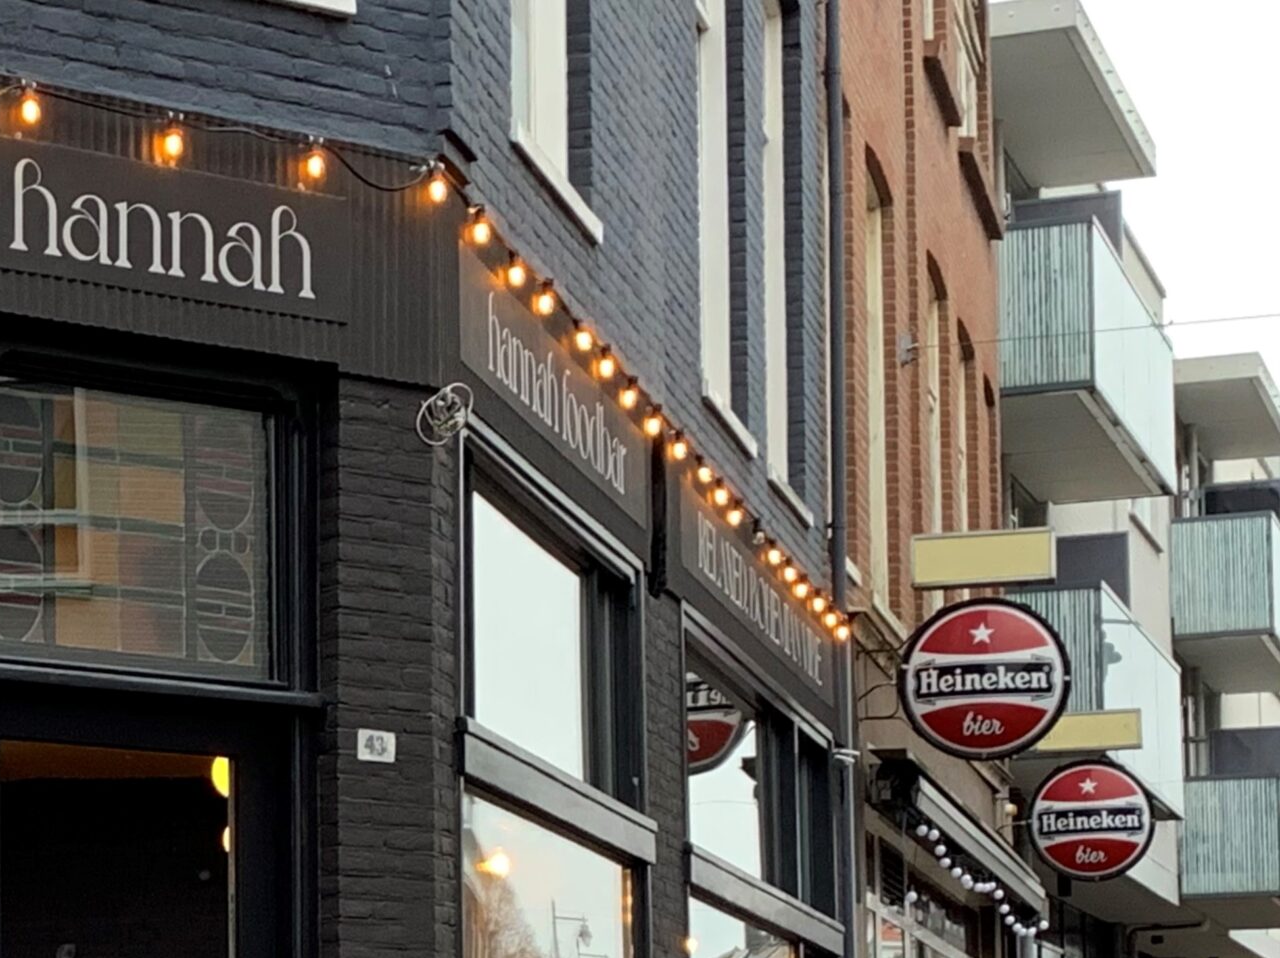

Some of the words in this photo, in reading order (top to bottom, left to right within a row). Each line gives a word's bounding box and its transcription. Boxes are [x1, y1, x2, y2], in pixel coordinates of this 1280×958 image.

[9, 158, 316, 299] hannah
[919, 665, 1049, 694] Heineken
[962, 711, 1006, 736] bier
[1041, 810, 1139, 832] Heineken
[1075, 845, 1108, 864] bier
